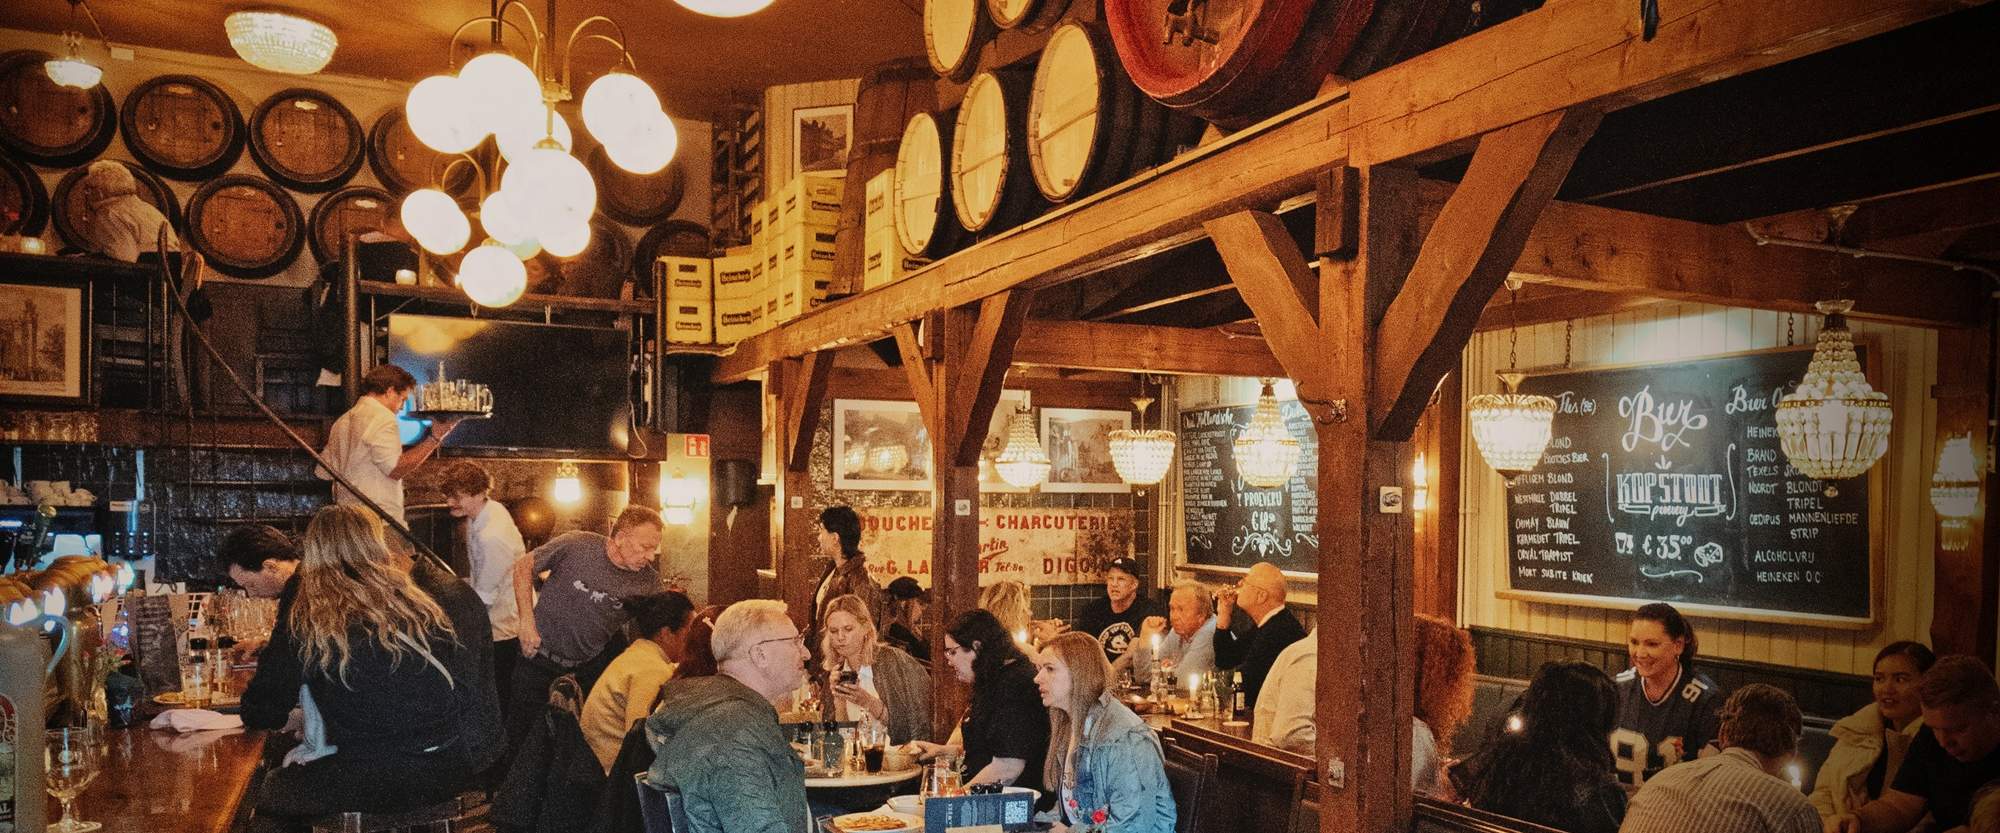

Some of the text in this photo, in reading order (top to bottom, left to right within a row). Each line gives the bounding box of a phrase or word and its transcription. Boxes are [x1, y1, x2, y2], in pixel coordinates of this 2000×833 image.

[1747, 448, 1777, 462] BRAND
[1787, 497, 1824, 510] TRIPEL
[1749, 512, 1859, 526] OEDIPUS MANNENLIEFDE
[1790, 527, 1819, 540] STRIP
[1757, 571, 1800, 583] HEINEKEN
